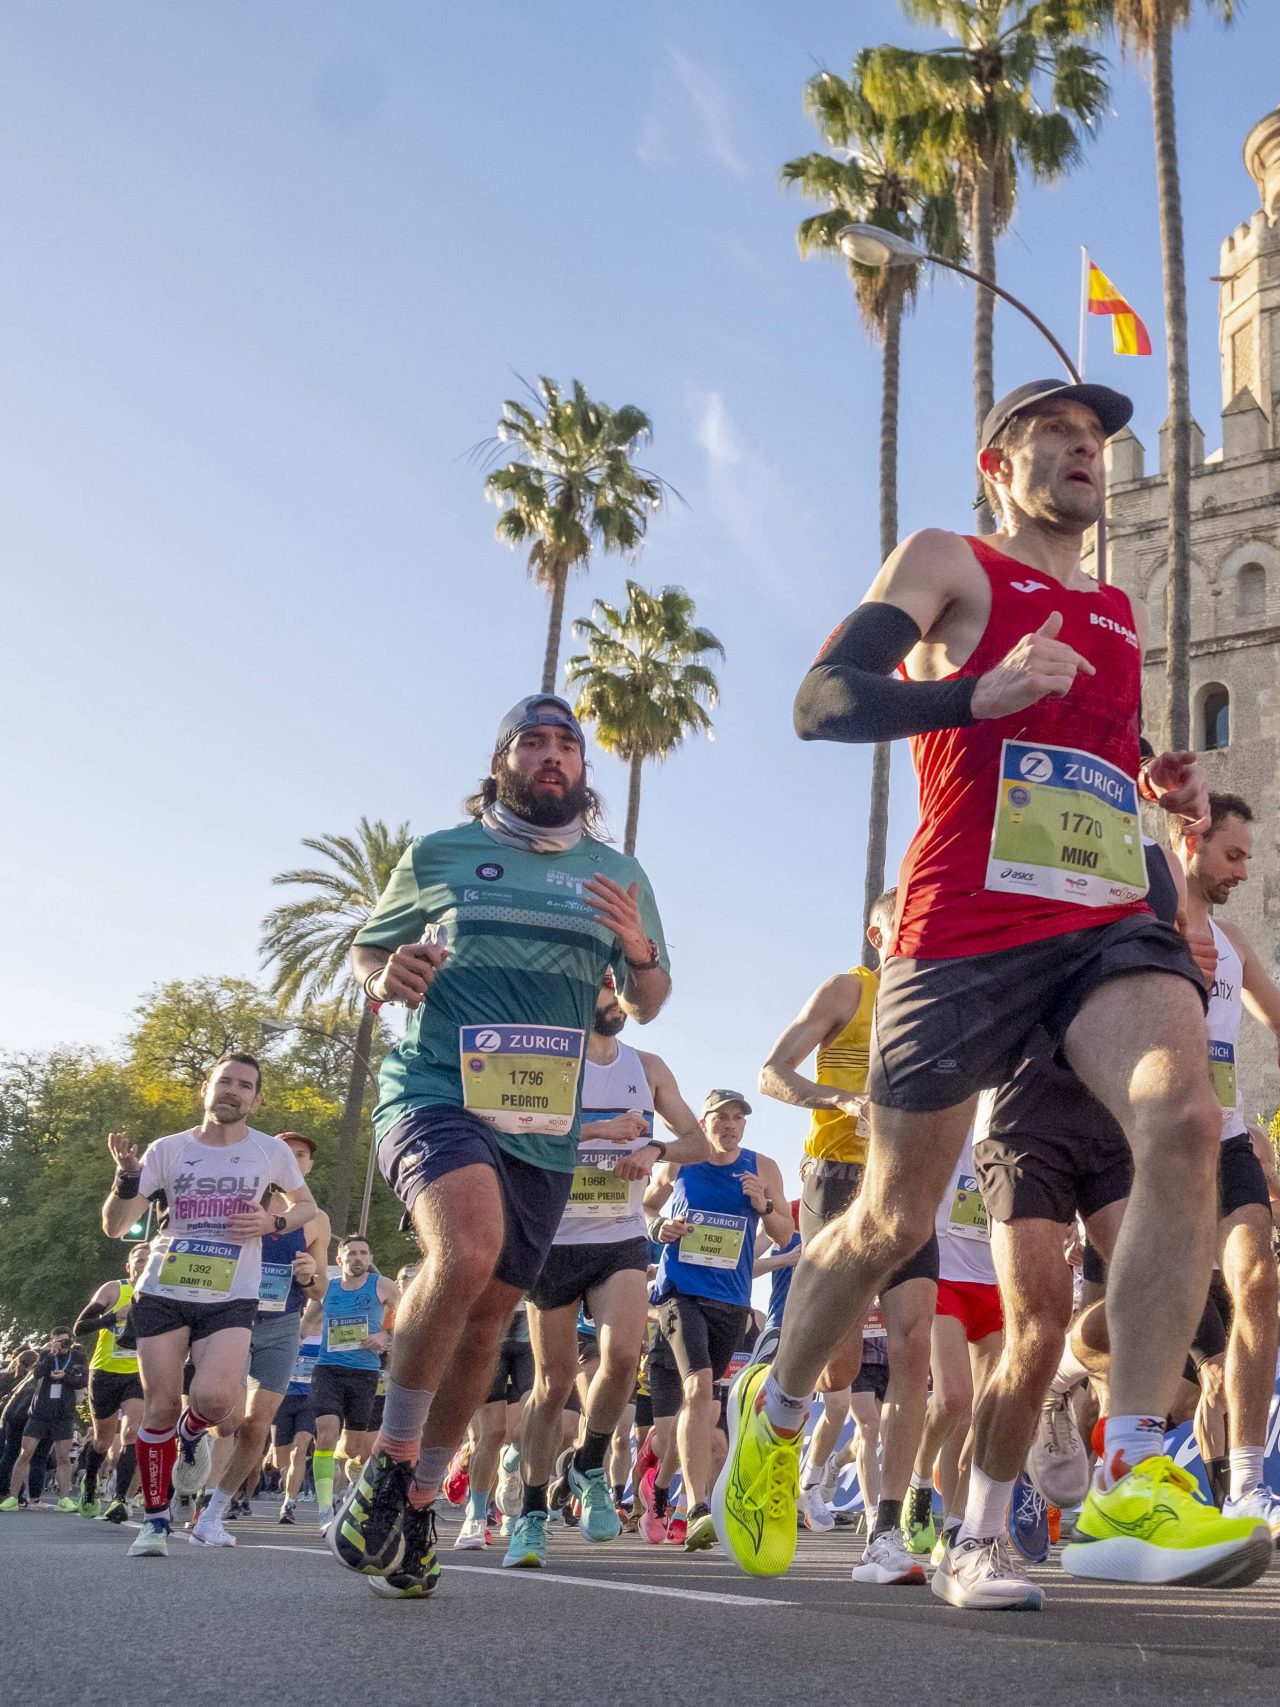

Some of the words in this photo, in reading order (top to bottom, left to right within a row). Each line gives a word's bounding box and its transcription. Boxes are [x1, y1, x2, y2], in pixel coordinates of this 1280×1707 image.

[1063, 763, 1125, 803] ZURICH
[1061, 811, 1103, 839] 1770
[1061, 846, 1099, 869] MIKI
[1011, 869, 1035, 881] asics
[508, 1034, 570, 1052] ZURICH
[1210, 1046, 1229, 1058] RICH
[509, 1070, 544, 1087] 1796
[501, 1093, 549, 1109] PEDRITO
[581, 1176, 606, 1187] 1968
[567, 1191, 595, 1201] ANQUE
[597, 1192, 626, 1201] PIERDA
[707, 1216, 739, 1228] ZURICH
[703, 1233, 723, 1243] 1630
[192, 1243, 232, 1256] ZURICH
[188, 1263, 212, 1274] 1392
[179, 1276, 200, 1286] DANI
